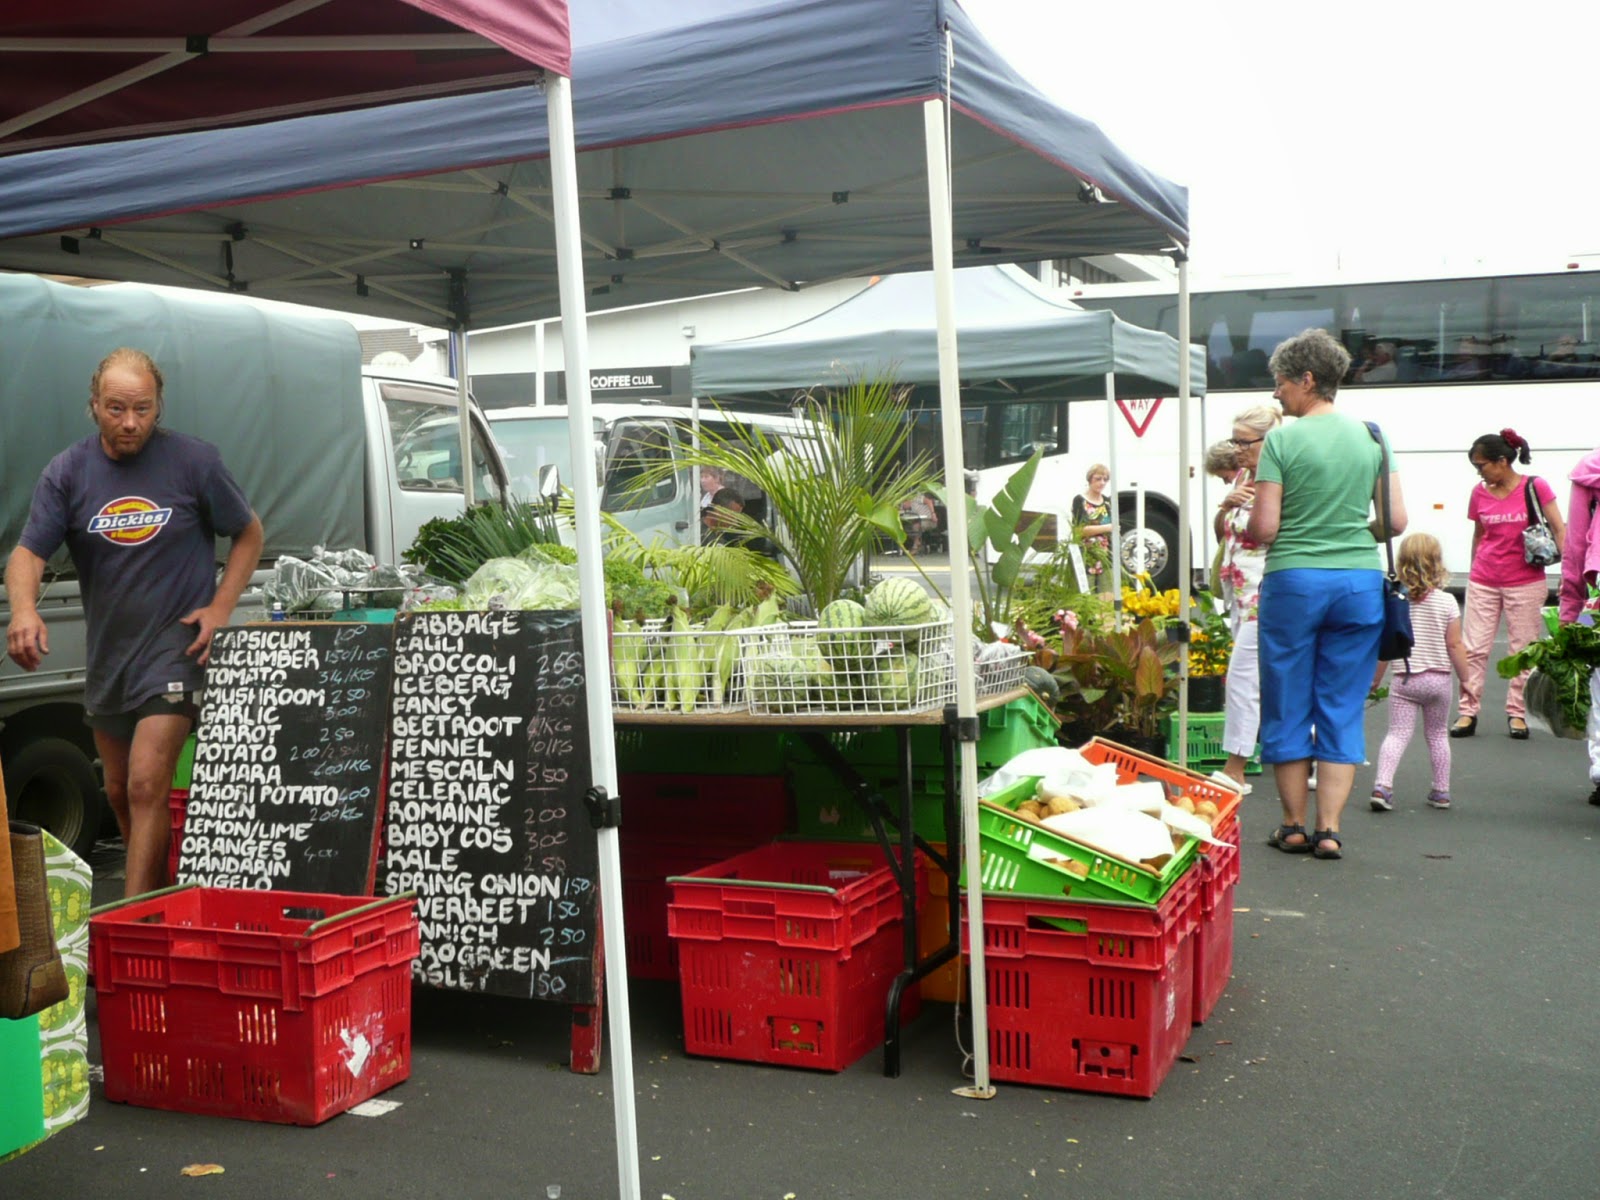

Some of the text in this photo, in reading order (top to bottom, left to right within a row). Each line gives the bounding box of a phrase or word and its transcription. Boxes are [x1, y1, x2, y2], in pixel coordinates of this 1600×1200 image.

[591, 375, 654, 388] COFFEE CLUB
[1130, 399, 1149, 410] WAY
[95, 513, 164, 529] Dickies
[1489, 512, 1528, 524] ZEALAN
[399, 611, 521, 639] ABBAGE
[213, 630, 311, 650] CAPSICUM
[209, 648, 319, 670] CUCUMBER
[394, 653, 516, 675] BROCCOLI
[206, 667, 287, 688] TOMATO
[393, 674, 512, 699] ICEBERG
[203, 687, 325, 707] MUSHROOM
[393, 695, 477, 716] FANCY
[201, 703, 279, 726] GARLIC
[198, 724, 282, 744] CARROT
[392, 715, 522, 737] BEETROOT
[195, 743, 277, 763] POTATO
[391, 738, 492, 758] FENNEL
[191, 763, 282, 786] KUMARA
[189, 784, 255, 804] MAORI
[261, 785, 339, 806] POTATO
[389, 780, 511, 804] CELERIAC
[187, 801, 256, 820] ONION
[389, 801, 500, 827] ROMAINE
[184, 818, 313, 843] LEMON/LIME
[388, 823, 455, 848] BABY
[459, 827, 513, 853] COS
[181, 837, 287, 860] ORANGES
[179, 856, 291, 877] MANDARIN
[387, 849, 460, 872] KALE
[176, 873, 272, 891] TANGELO
[385, 871, 474, 899] SPRING
[480, 874, 560, 899] ONION
[412, 896, 536, 924] VERBEET
[418, 921, 498, 945] NNICH
[421, 942, 550, 972] ROGREEN
[410, 959, 489, 990] RSLEY
